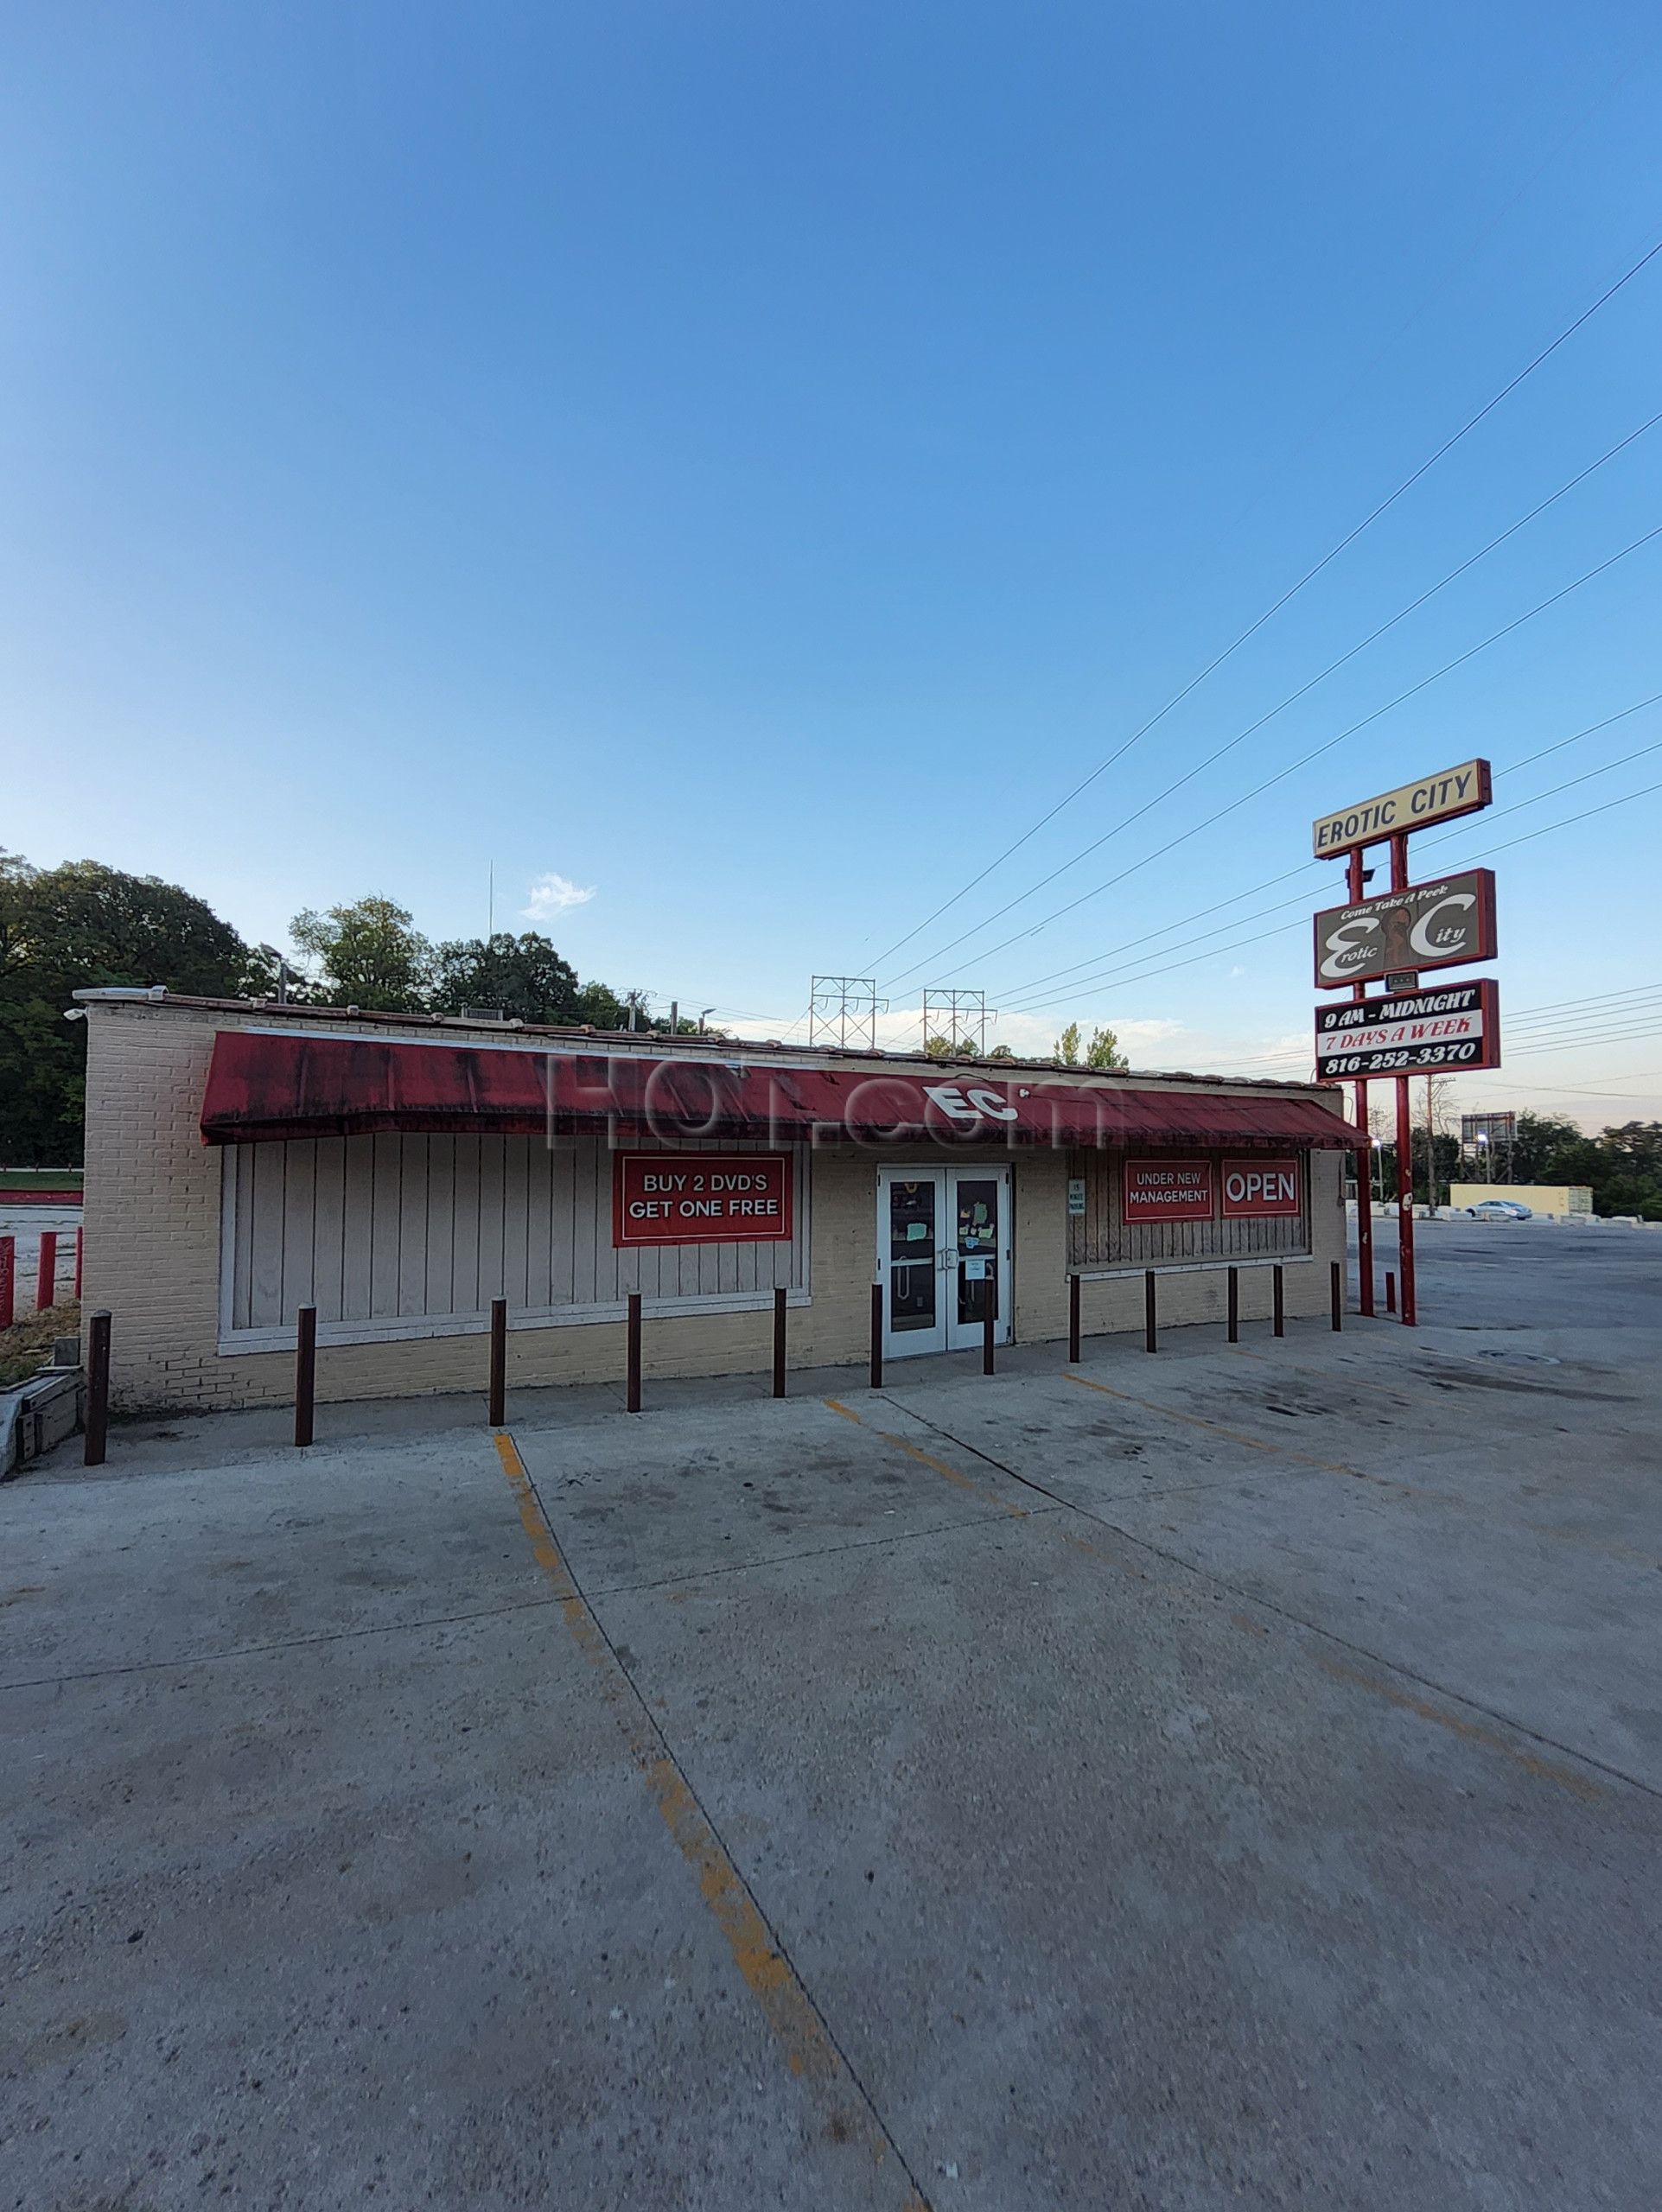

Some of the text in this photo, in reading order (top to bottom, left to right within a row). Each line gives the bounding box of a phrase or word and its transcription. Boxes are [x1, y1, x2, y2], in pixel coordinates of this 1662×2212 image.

[1317, 770, 1473, 849] EROTIC CITY
[1340, 885, 1449, 920] Come Take A Peek
[1320, 893, 1476, 978] Erotic City
[1324, 1013, 1337, 1029] 9
[1338, 1007, 1365, 1027] AM
[1379, 989, 1475, 1020] MIDNIGHT
[1326, 1016, 1473, 1051] 7 DAYS A WEEK
[1325, 1042, 1475, 1075] 816-252-3370
[922, 1085, 1018, 1121] EC
[643, 1174, 767, 1192] BUY 2 DVD'S
[1137, 1173, 1200, 1185] UNDER NEW
[1226, 1173, 1295, 1202] OPEN
[629, 1199, 778, 1218] GET ONE FREE
[1130, 1190, 1208, 1204] MANAGEMENT
